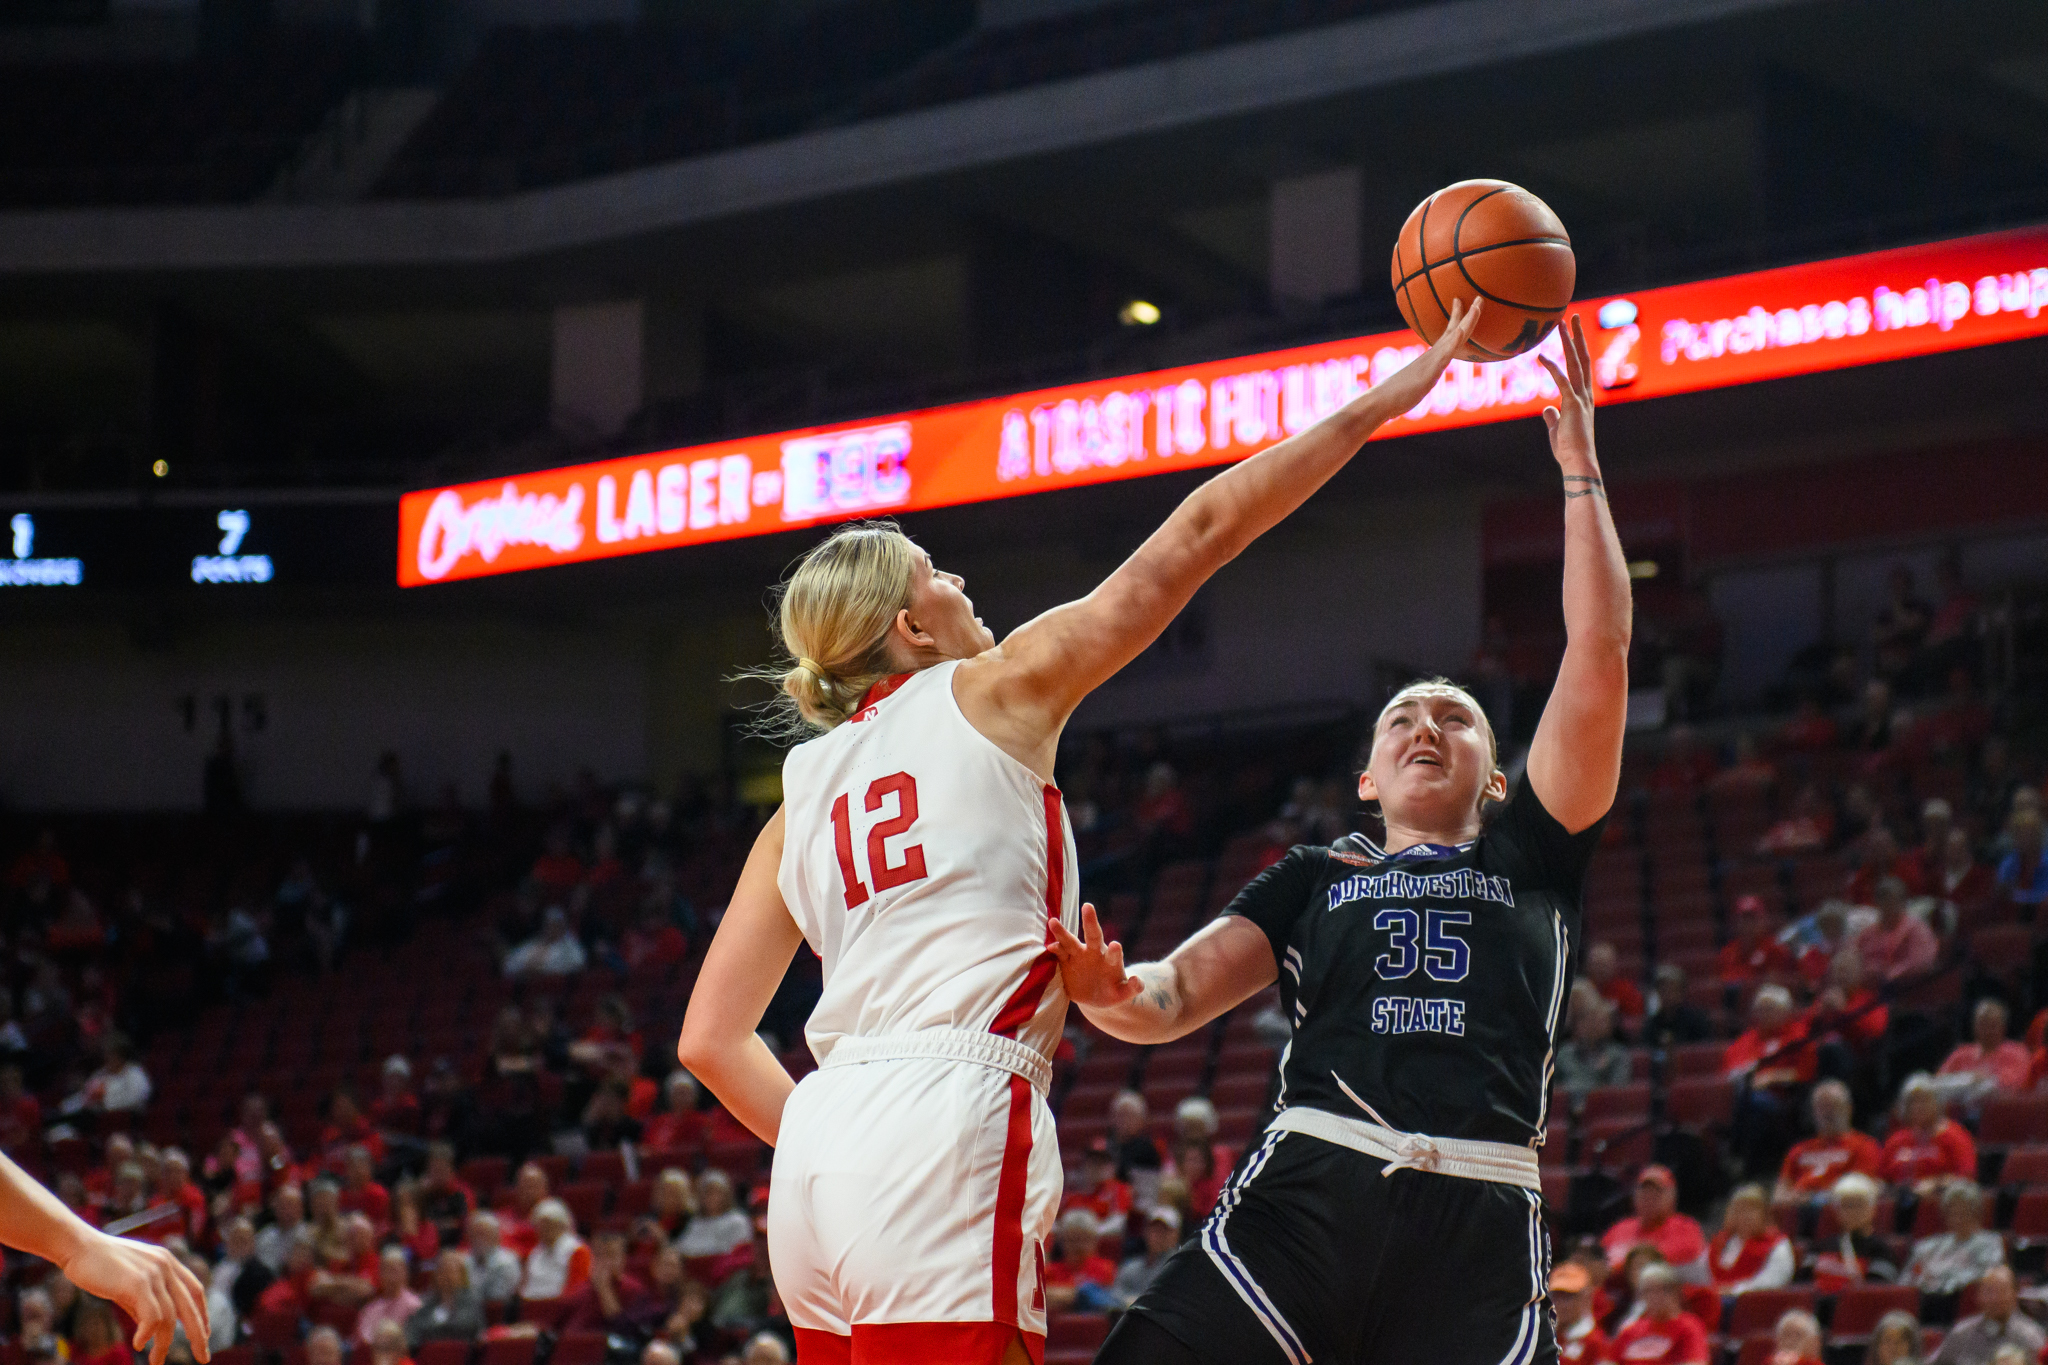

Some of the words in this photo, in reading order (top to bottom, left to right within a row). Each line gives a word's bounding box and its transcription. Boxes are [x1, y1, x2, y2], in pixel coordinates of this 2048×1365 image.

[1661, 295, 1871, 365] Purchases
[1873, 277, 1970, 333] help
[597, 453, 752, 544] LAGER
[11, 513, 34, 558] 1
[217, 510, 251, 555] 7
[830, 770, 928, 911] 12
[1328, 869, 1515, 911] NORTHWESTERN
[1374, 909, 1472, 982] 35
[1371, 997, 1466, 1037] STATE
